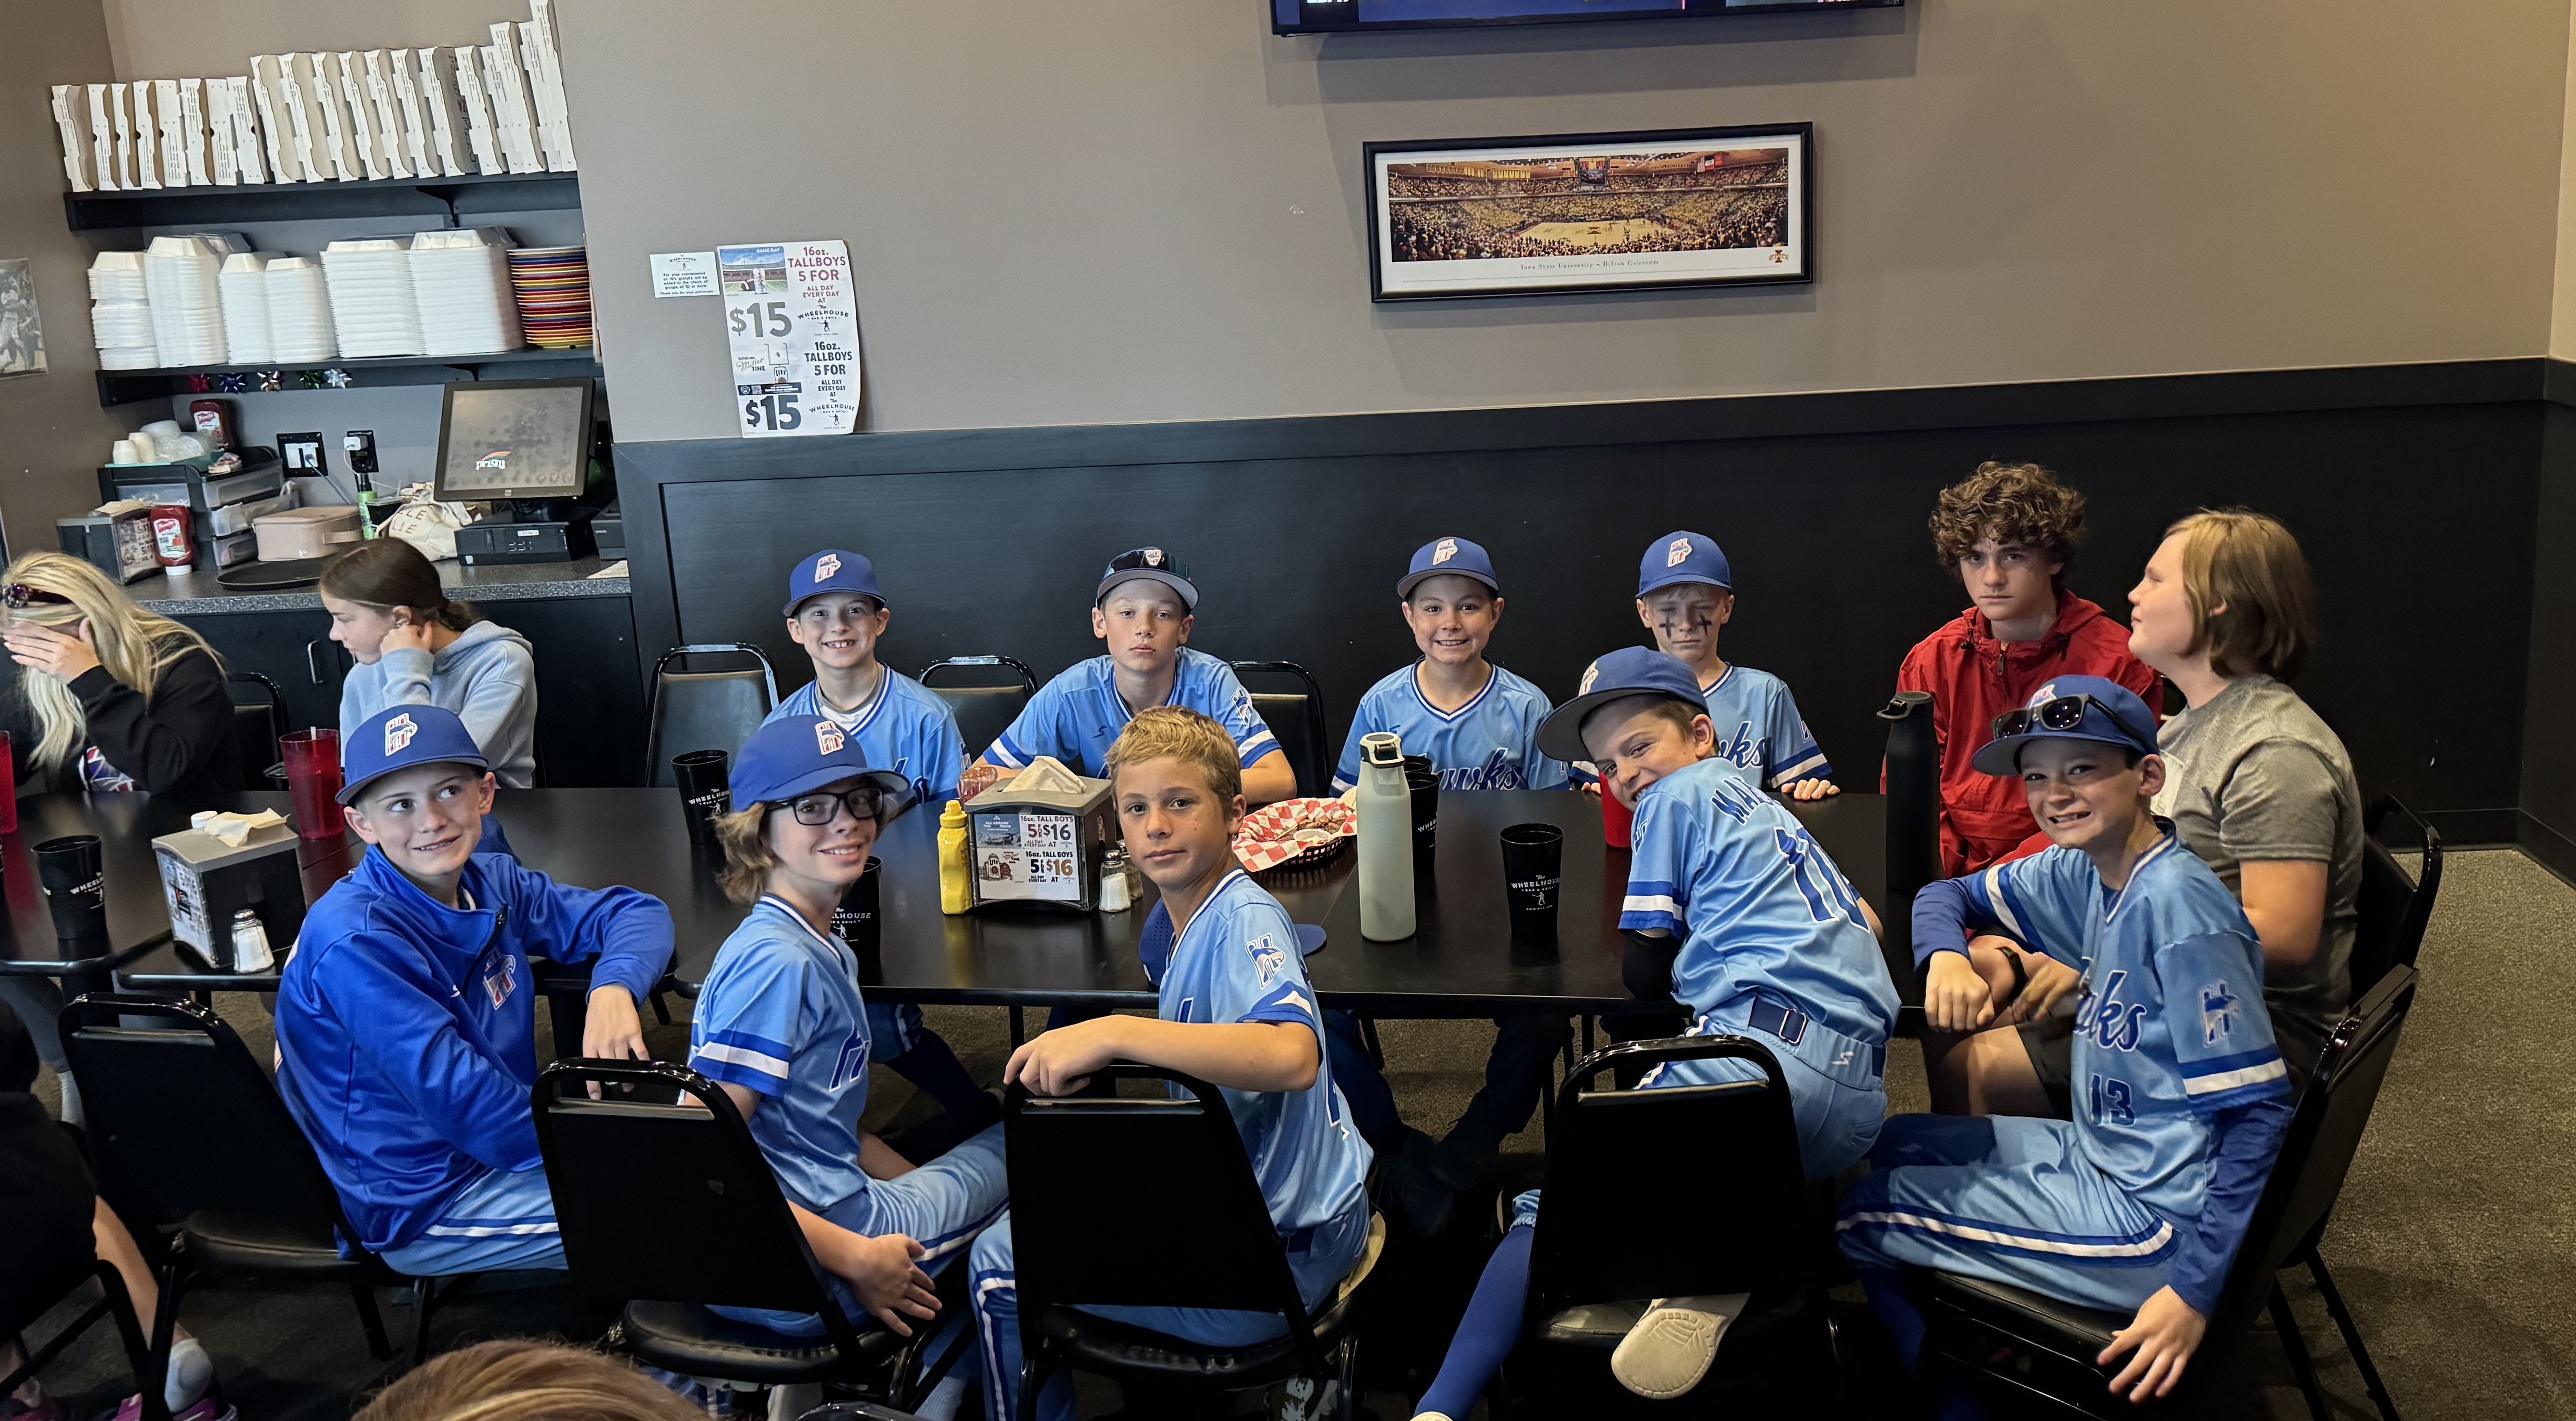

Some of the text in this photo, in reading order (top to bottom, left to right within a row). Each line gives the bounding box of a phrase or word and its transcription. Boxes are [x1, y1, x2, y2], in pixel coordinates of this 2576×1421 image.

[804, 246, 829, 256] 16oz.
[787, 256, 846, 268] TALLBOYS
[798, 269, 839, 282] 5 FOR
[729, 301, 792, 338] $15
[797, 310, 849, 319] WHEELHOUSE
[815, 341, 840, 351] 16oz.
[804, 351, 853, 362] TALLBOYS
[814, 364, 846, 376] 5 FOR
[746, 394, 802, 430] $15
[809, 404, 855, 412] WHEELHOUSE
[1028, 824, 1037, 838] 5
[1043, 823, 1071, 840] $16
[1030, 859, 1040, 873] 5
[1046, 859, 1073, 876] $16
[2088, 1072, 2137, 1127] 13
